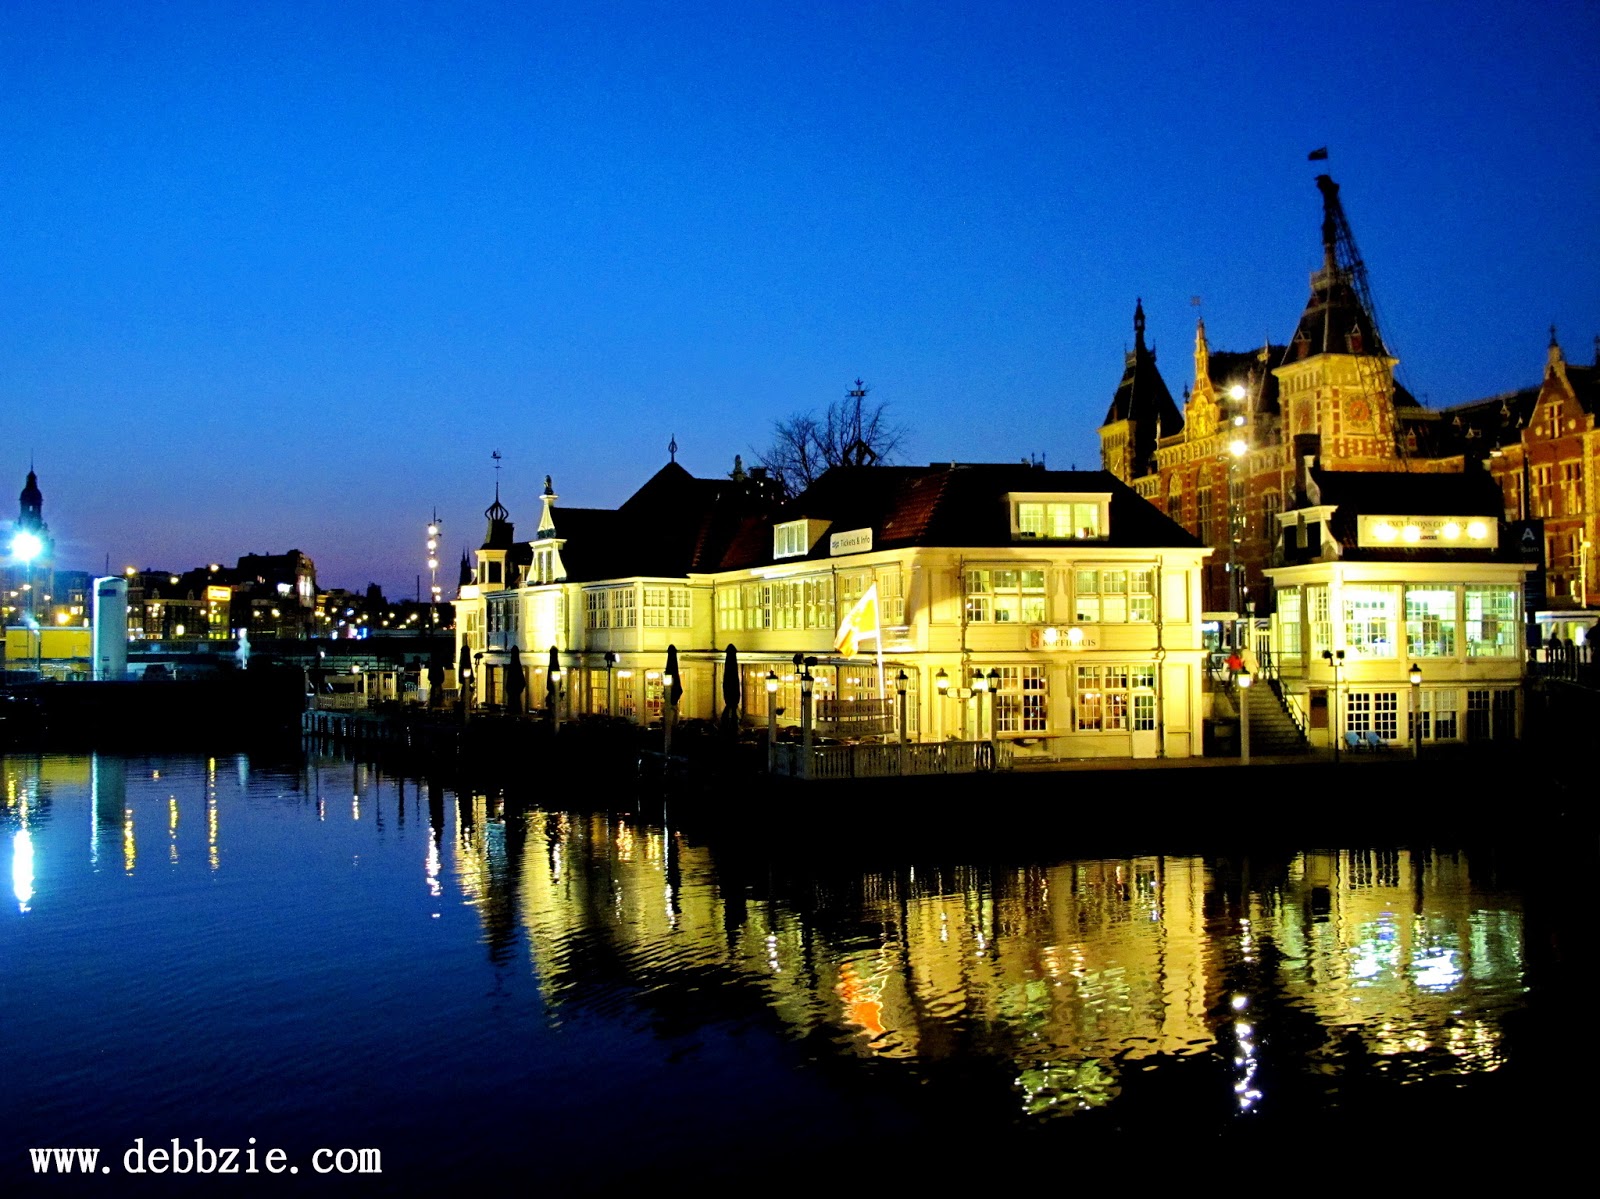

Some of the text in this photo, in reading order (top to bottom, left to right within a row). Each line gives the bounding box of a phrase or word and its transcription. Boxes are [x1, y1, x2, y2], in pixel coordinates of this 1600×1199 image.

[1521, 527, 1535, 541] A
[840, 538, 856, 547] Tickets
[860, 535, 871, 544] Info
